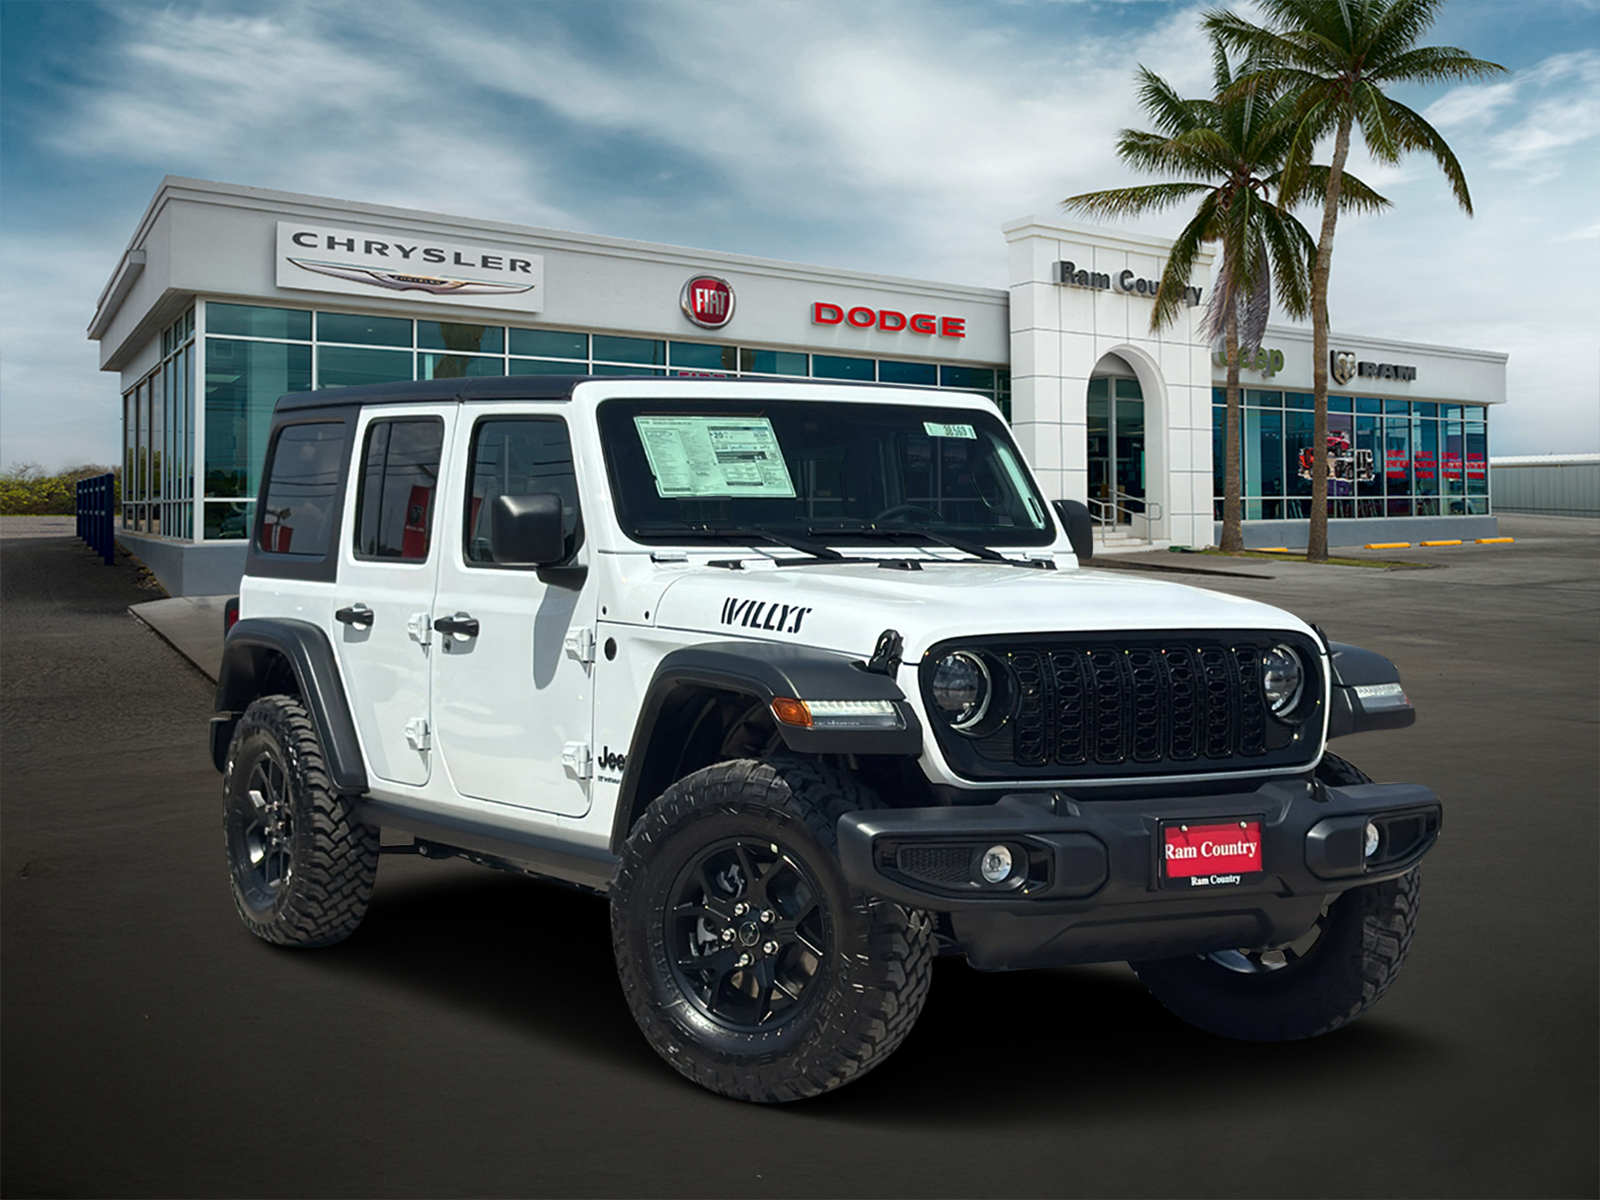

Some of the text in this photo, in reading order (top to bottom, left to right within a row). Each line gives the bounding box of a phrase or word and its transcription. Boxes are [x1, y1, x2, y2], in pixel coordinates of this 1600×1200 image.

[291, 231, 533, 274] CHRYSLER
[1055, 260, 1111, 291] Ram
[694, 287, 728, 317] FIAT
[812, 301, 966, 339] DODGE
[1358, 361, 1417, 381] RAM
[720, 596, 813, 634] WILLYS
[597, 745, 629, 772] Jee
[1165, 840, 1258, 860] Ram Country
[1191, 874, 1241, 886] Ram Country
